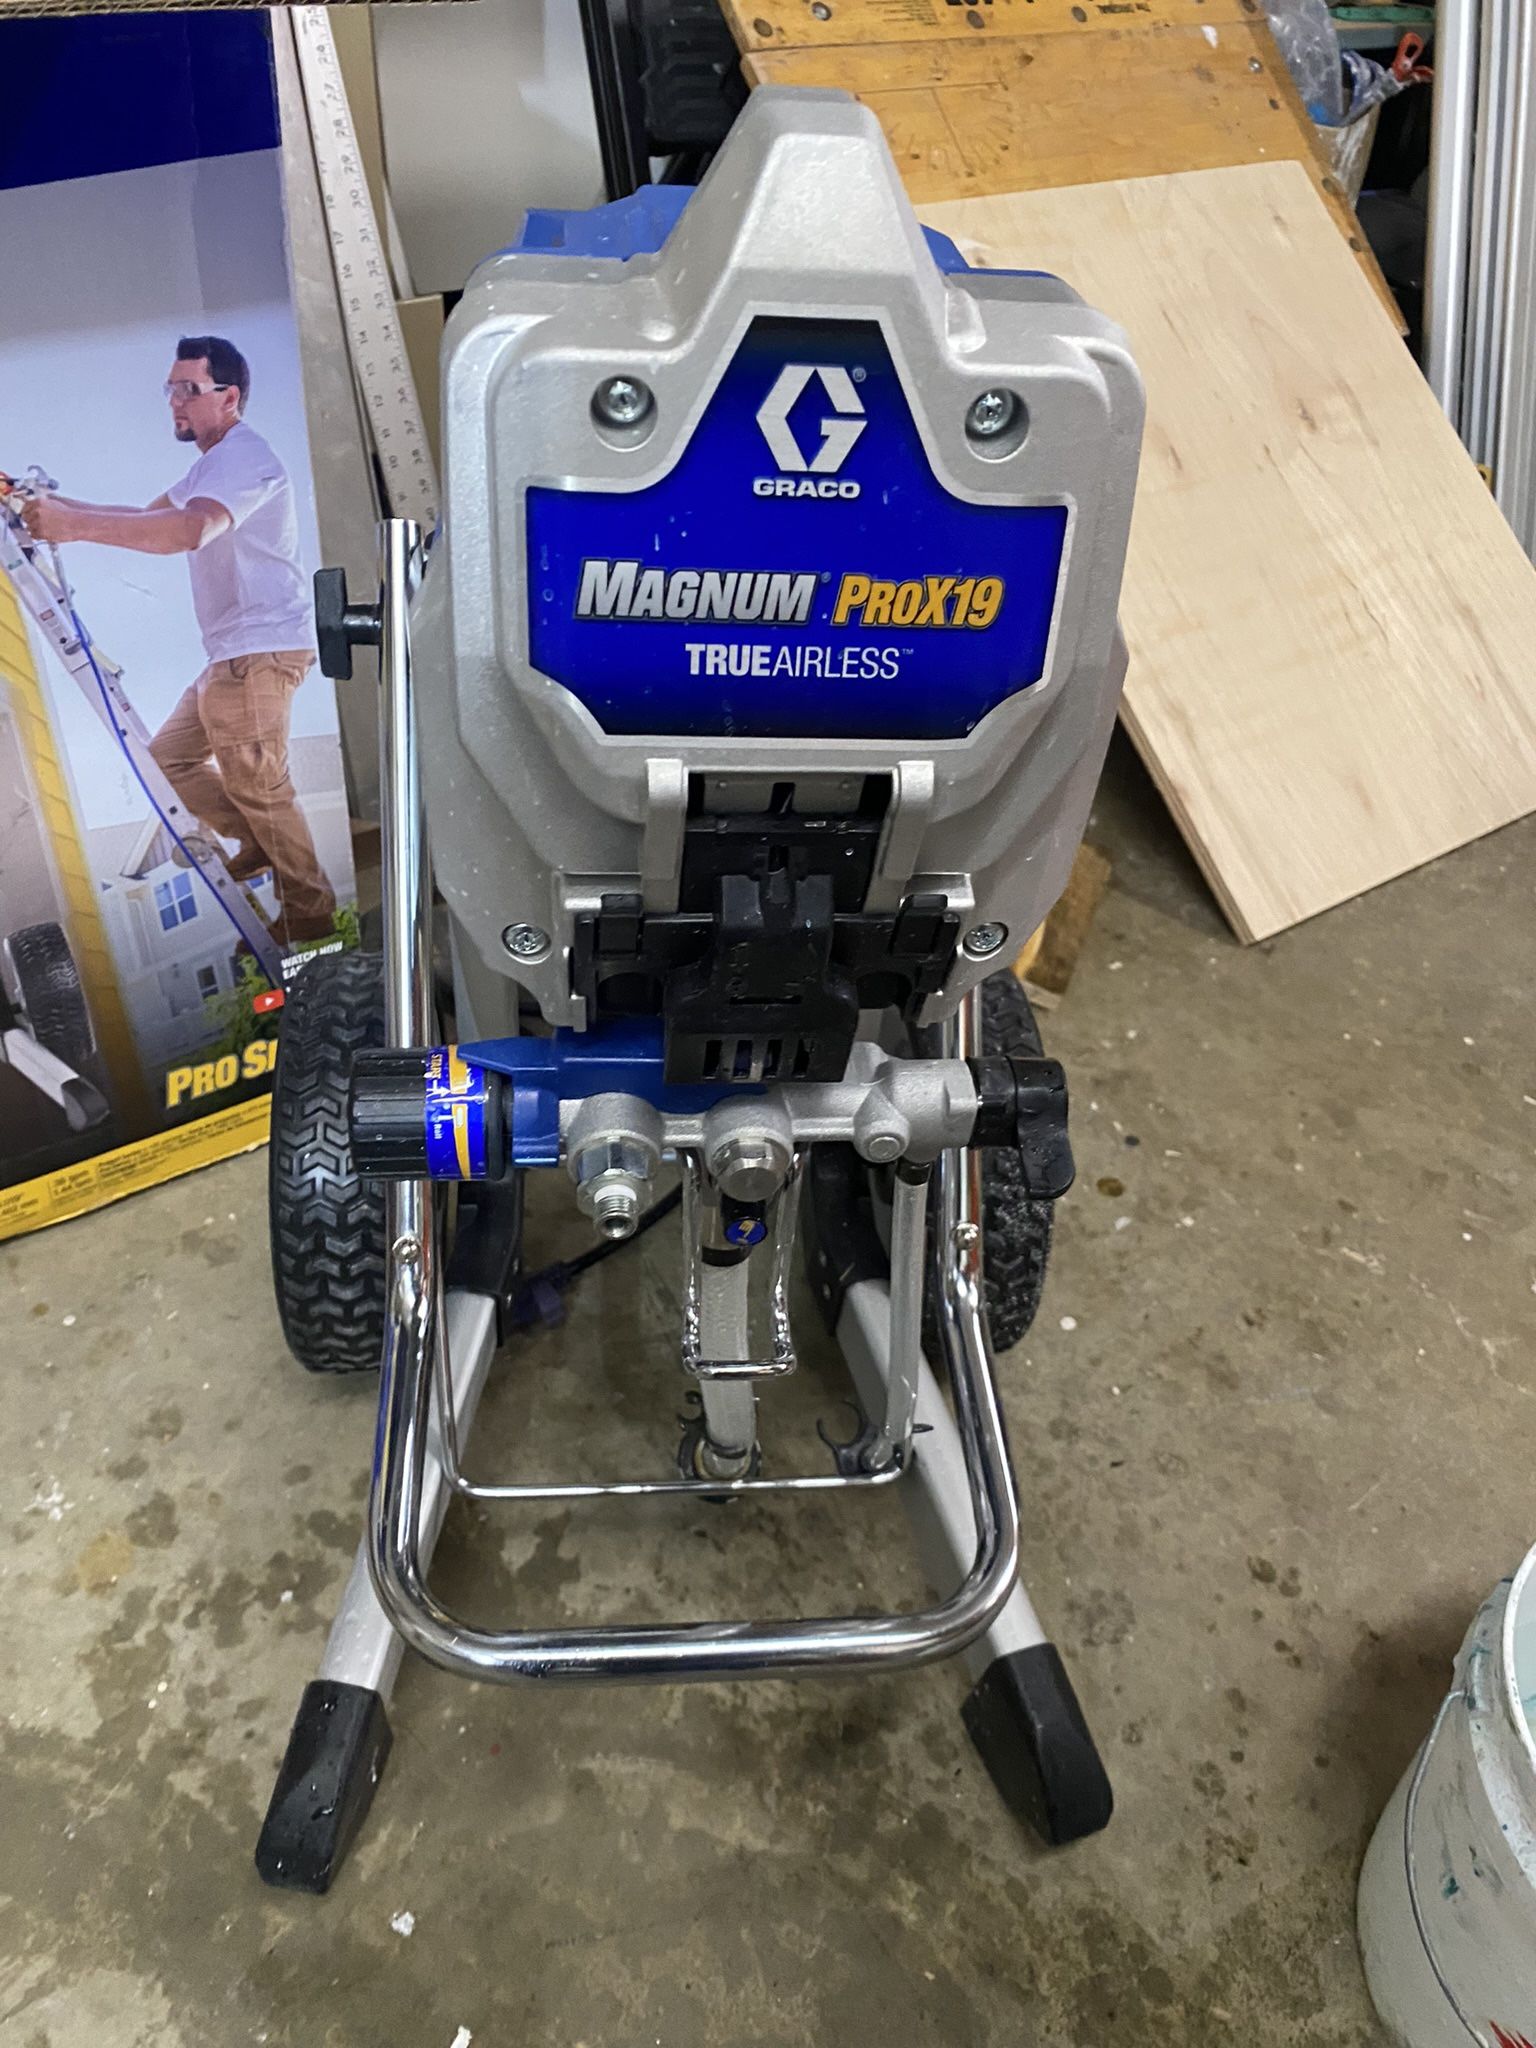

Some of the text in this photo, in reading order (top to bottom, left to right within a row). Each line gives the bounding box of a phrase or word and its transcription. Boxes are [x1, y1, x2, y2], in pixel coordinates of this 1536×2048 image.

[350, 189, 363, 208] 30
[753, 477, 861, 499] GRACO
[575, 559, 818, 625] MAGNUM
[281, 941, 343, 969] WATCH NOW
[166, 1054, 239, 1109] PRO
